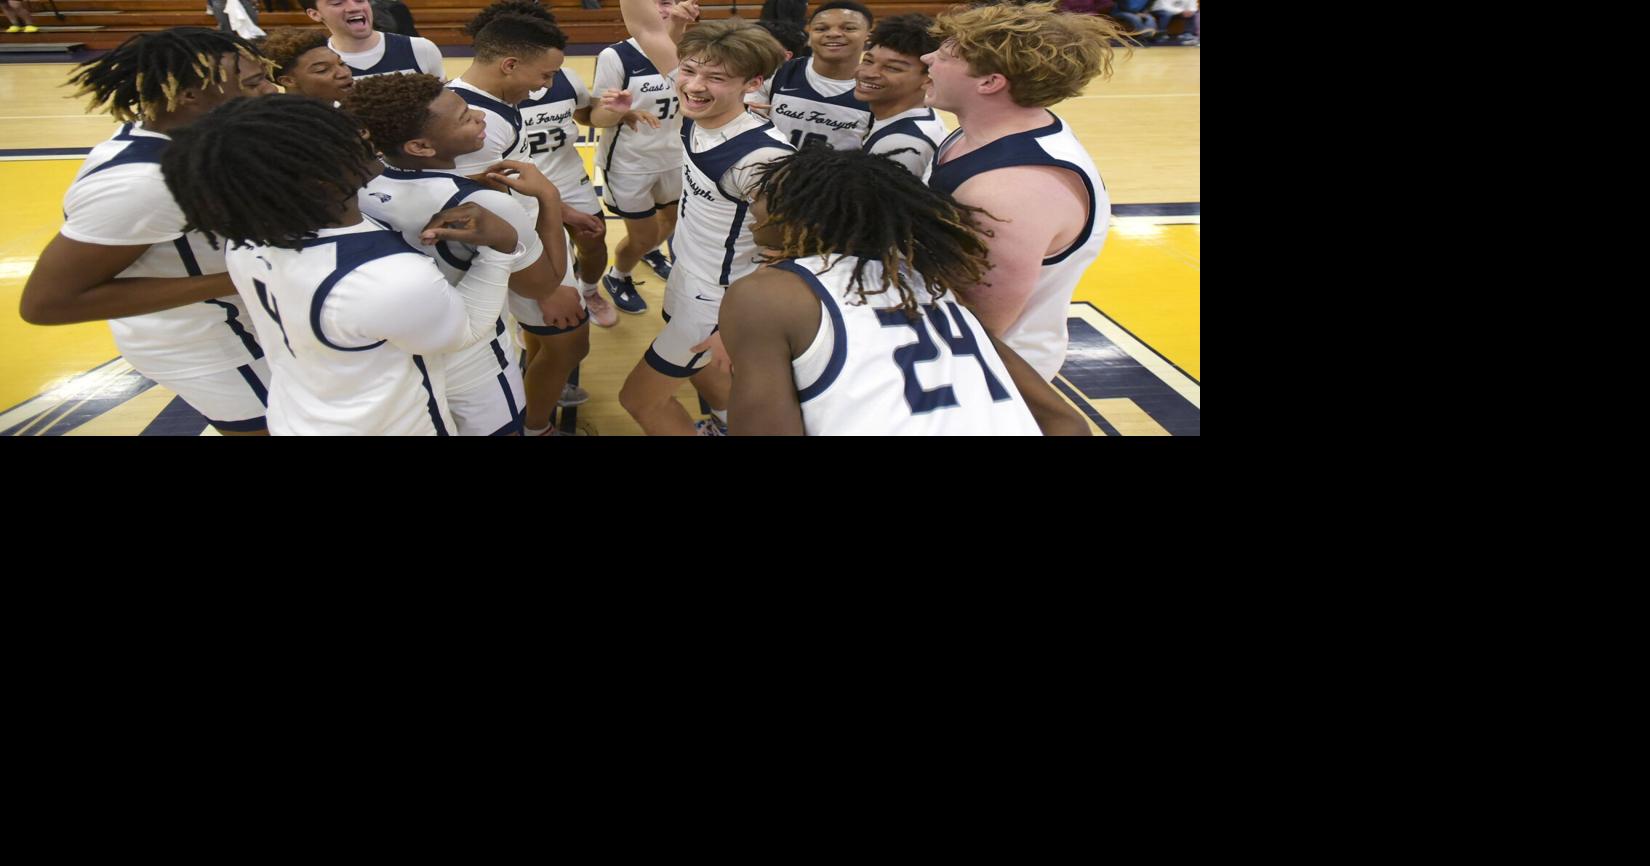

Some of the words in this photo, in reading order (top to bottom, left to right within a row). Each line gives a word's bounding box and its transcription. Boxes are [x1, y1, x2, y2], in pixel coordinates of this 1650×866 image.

[640, 81, 665, 93] East
[536, 107, 572, 125] Forsyth
[775, 103, 805, 120] East
[805, 110, 860, 131] Forsyth
[527, 127, 567, 155] 23
[252, 277, 297, 359] 4
[871, 300, 1013, 416] 24
